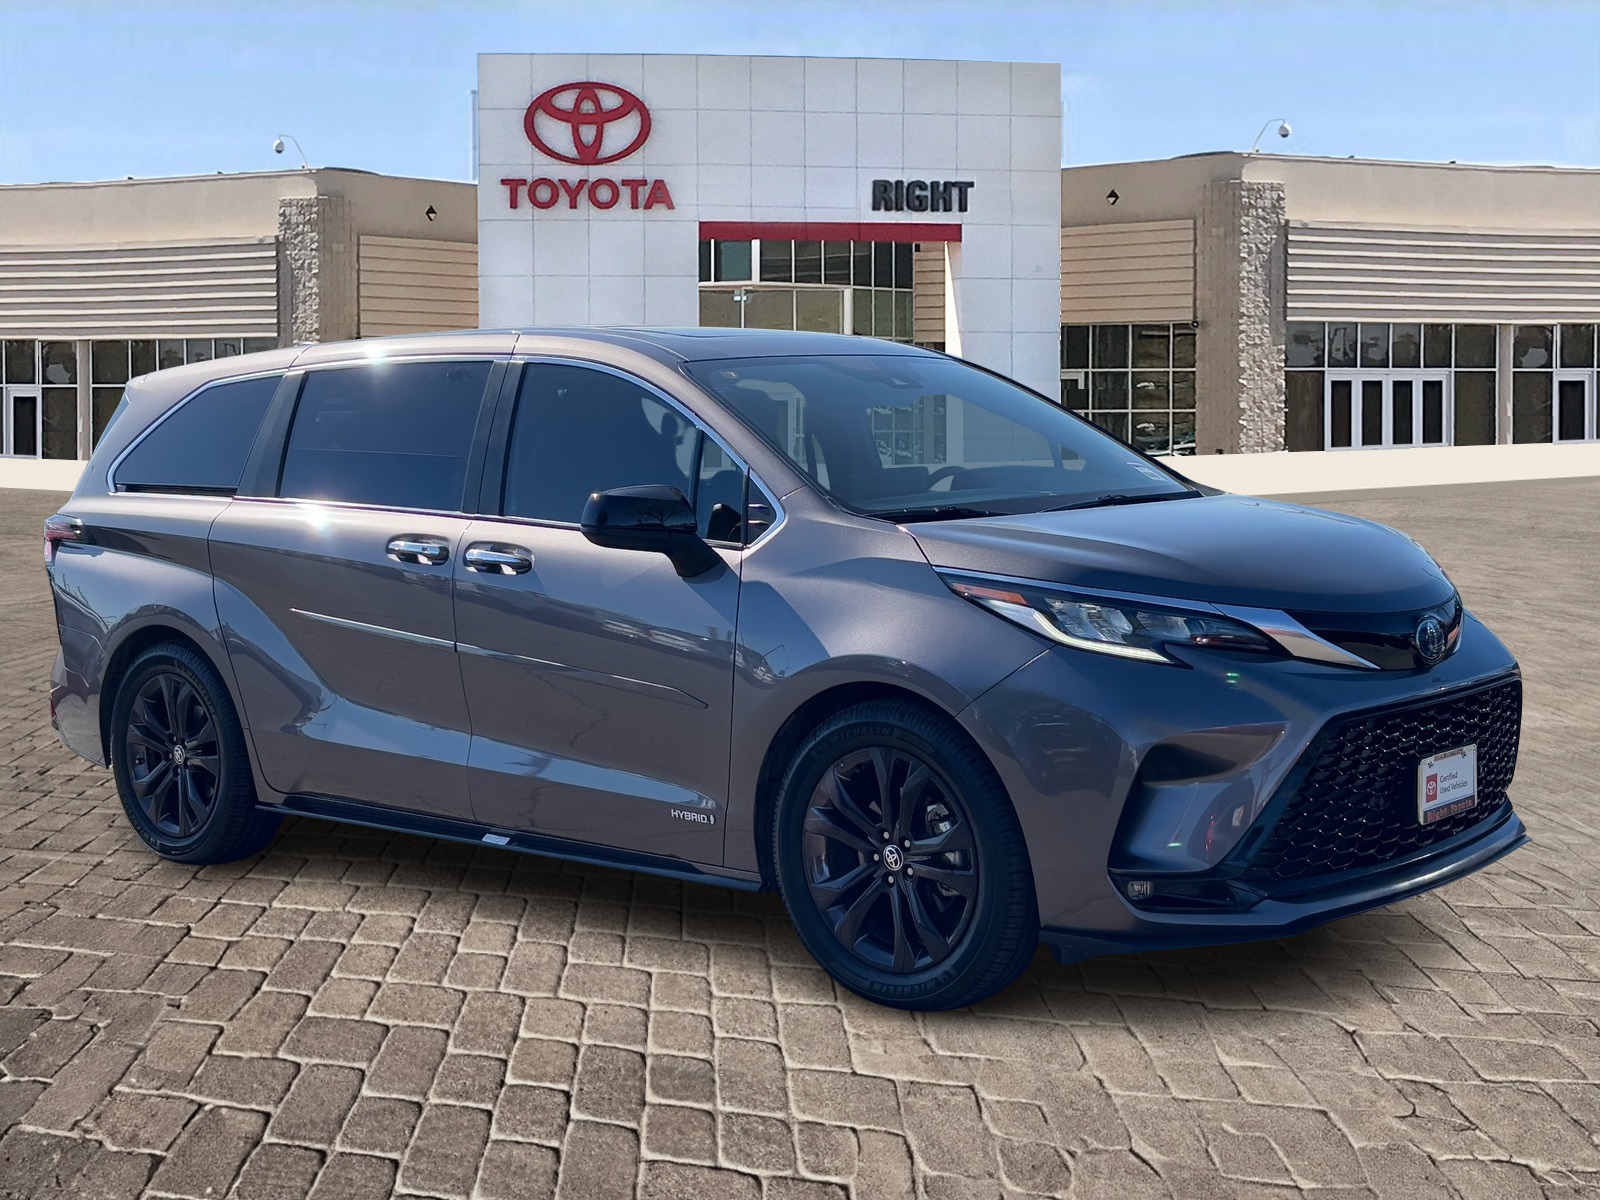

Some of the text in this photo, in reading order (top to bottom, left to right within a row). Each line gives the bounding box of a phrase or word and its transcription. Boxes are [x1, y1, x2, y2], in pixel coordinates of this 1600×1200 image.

[500, 177, 675, 209] TOYOTA
[871, 179, 974, 212] RIGHT
[1440, 771, 1458, 783] Certified
[1440, 780, 1468, 794] Used Vehicles
[671, 808, 707, 823] HYBRID
